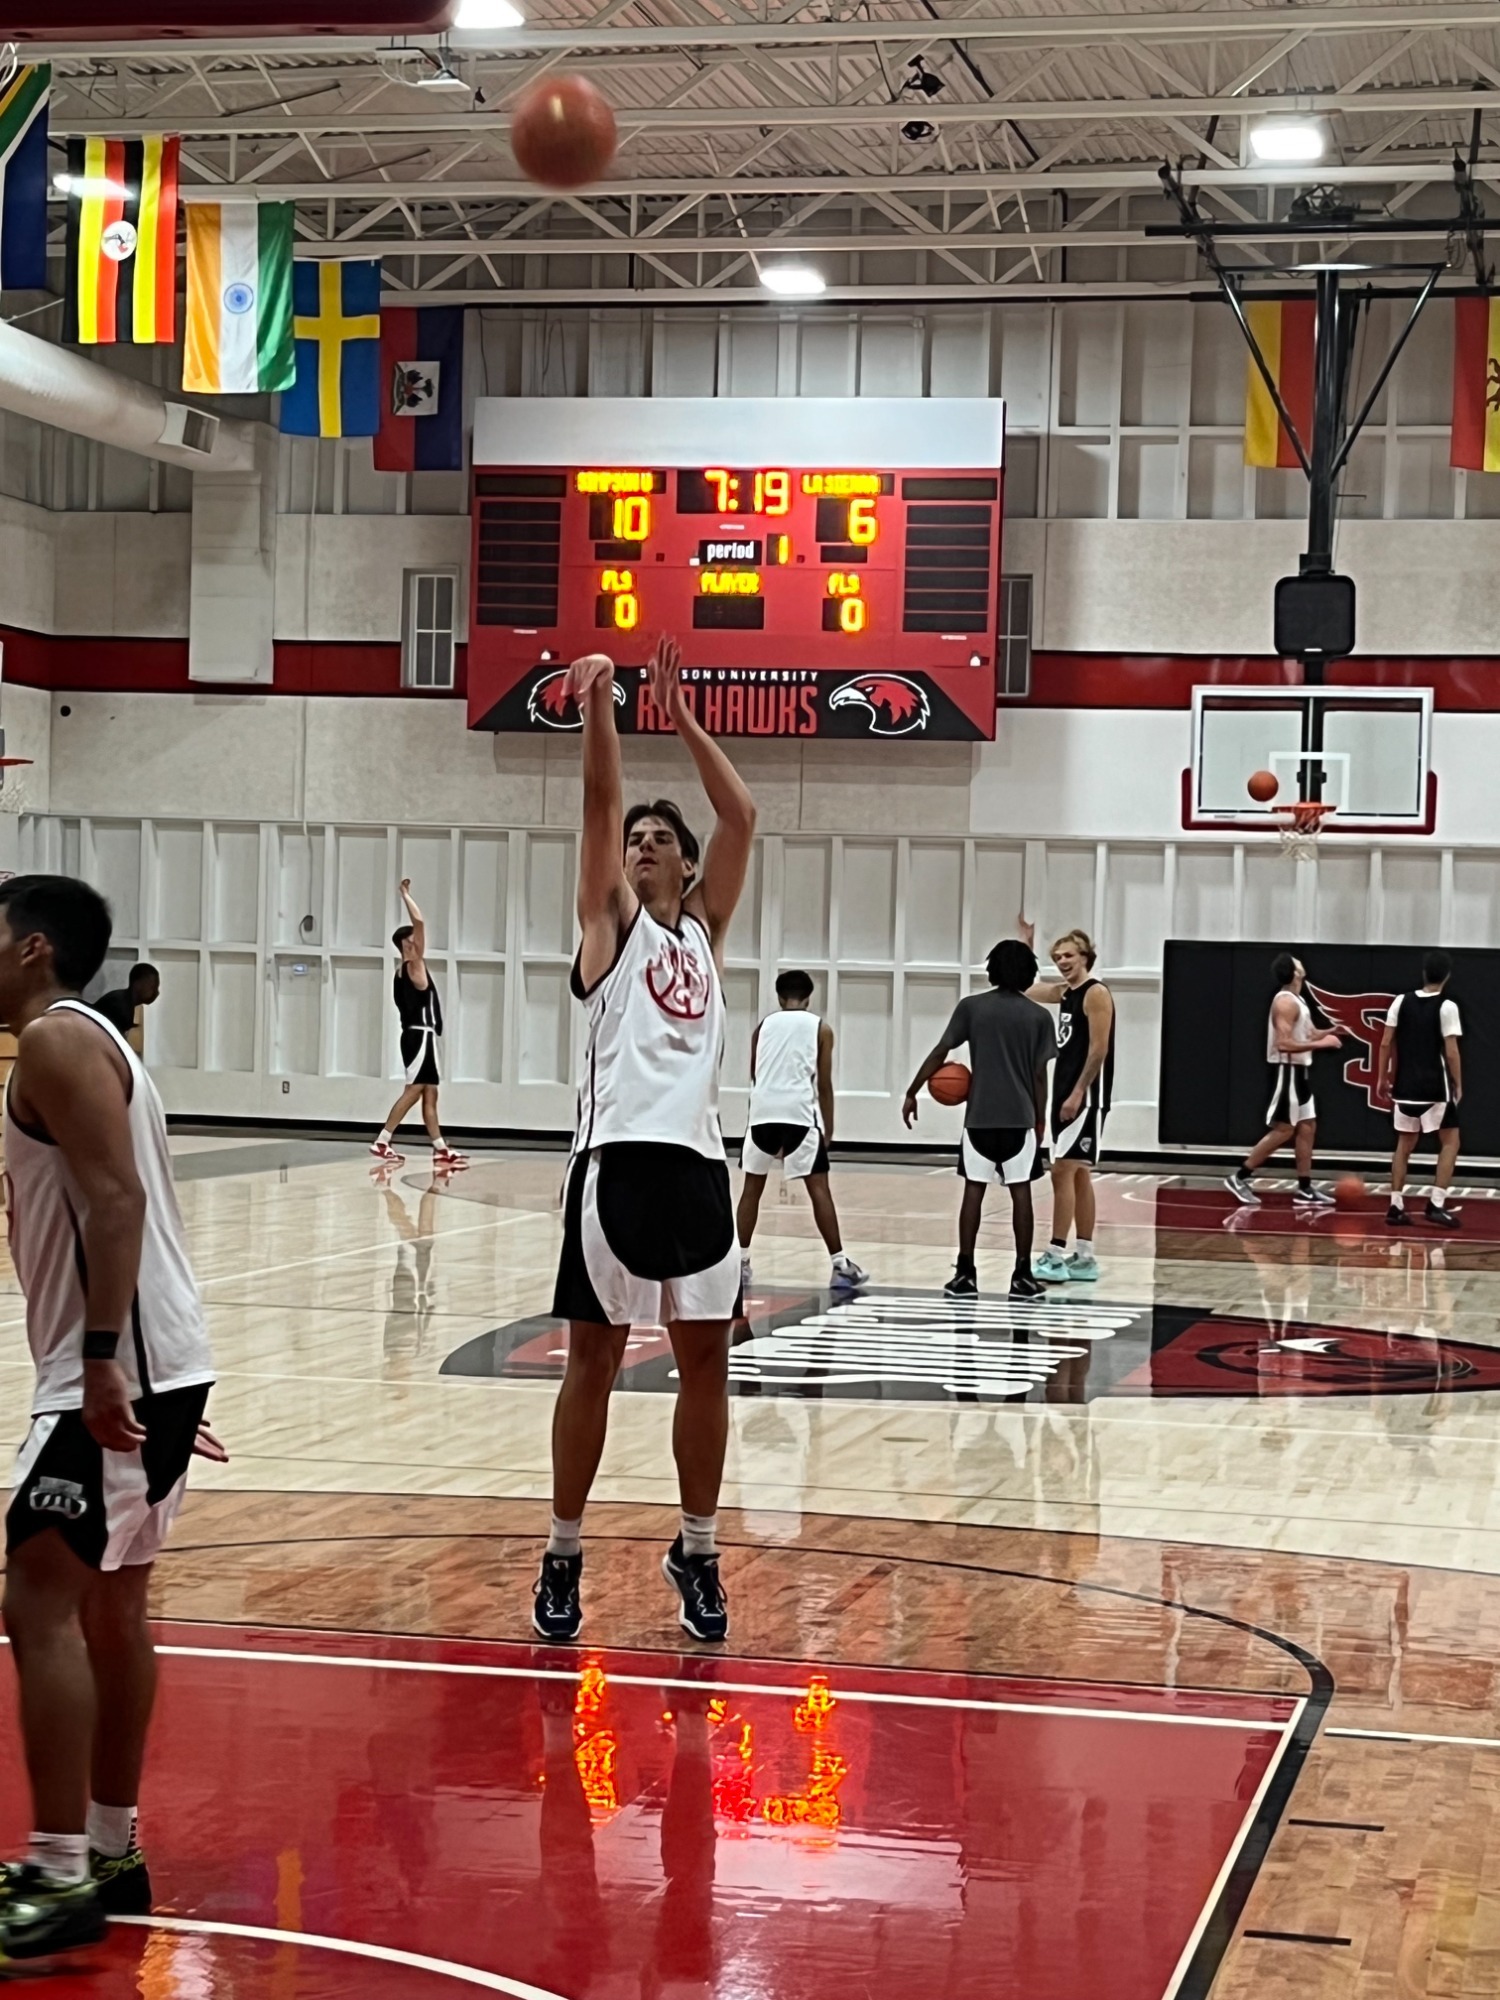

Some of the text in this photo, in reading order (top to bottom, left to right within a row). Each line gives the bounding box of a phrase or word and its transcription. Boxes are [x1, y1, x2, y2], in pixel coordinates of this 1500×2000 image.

[704, 469, 789, 515] 7:19
[613, 496, 648, 540] 10
[848, 498, 877, 544] 6
[707, 540, 754, 562] period
[778, 534, 790, 565] 1
[614, 593, 637, 629] 0
[840, 597, 864, 632] 0
[640, 668, 818, 682] SSON UNIVERSITY
[704, 685, 818, 735] HAWKS
